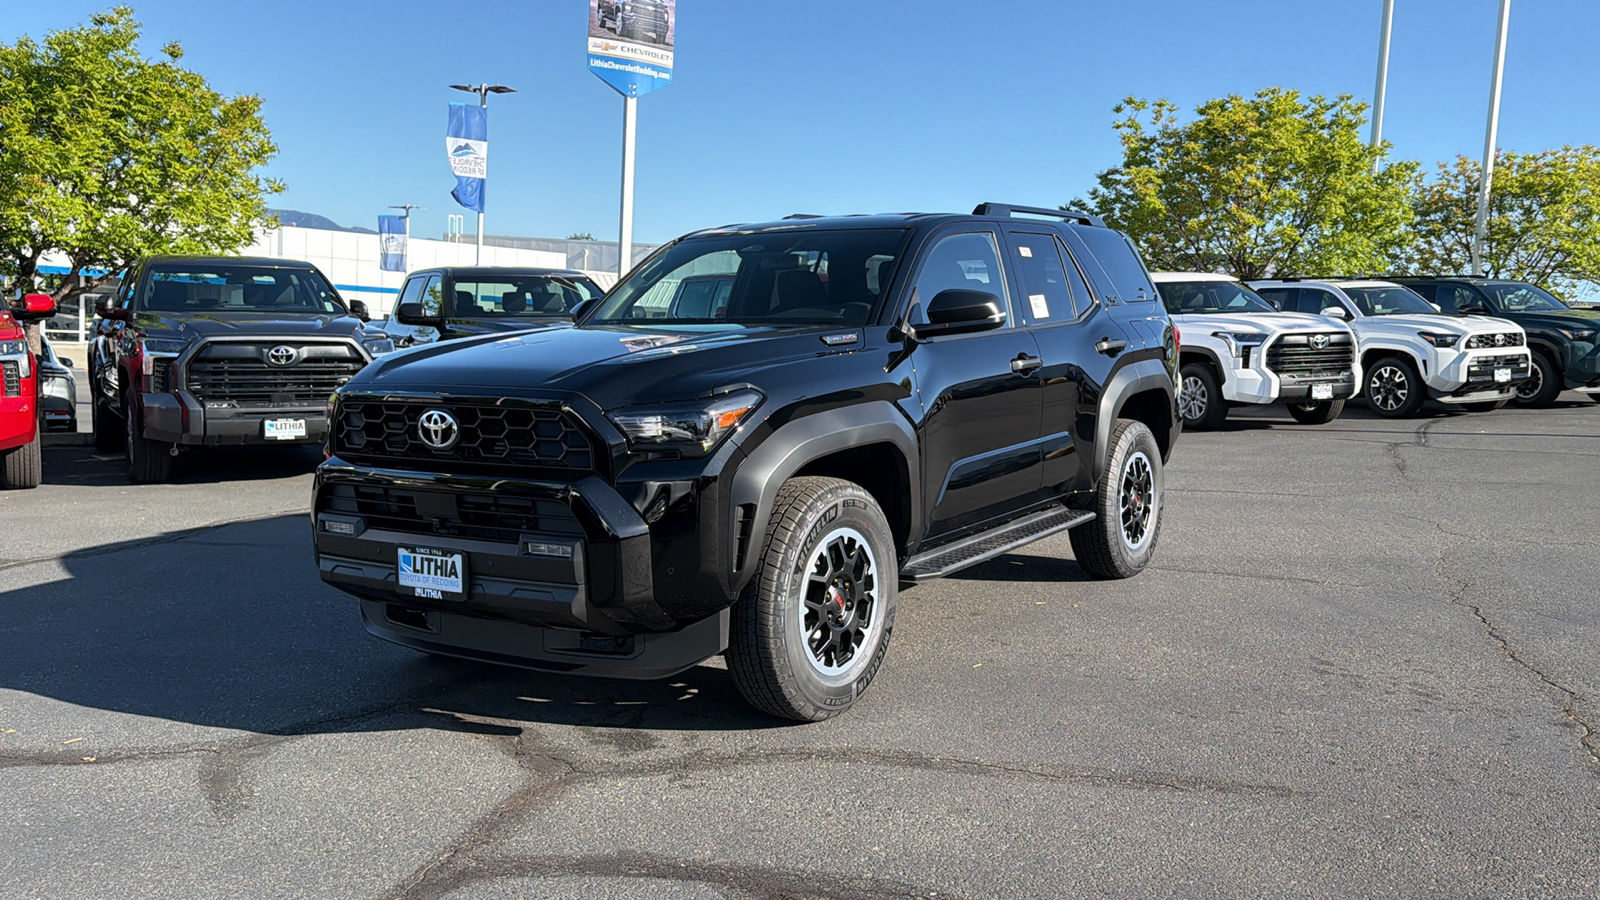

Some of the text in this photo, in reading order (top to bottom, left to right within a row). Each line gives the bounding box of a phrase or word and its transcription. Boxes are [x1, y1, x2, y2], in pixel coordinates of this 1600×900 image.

[620, 45, 670, 61] CHEVROLET
[590, 58, 670, 79] LithiaChevroletRedding.com
[275, 422, 304, 430] LITHIA
[798, 504, 838, 568] MICHELIN
[415, 547, 430, 555] SINCE
[412, 555, 459, 579] LITHIA
[400, 573, 460, 588] TOYOTA OF REDDING
[420, 588, 443, 600] LITHIA
[857, 630, 890, 694] MICHELIN
